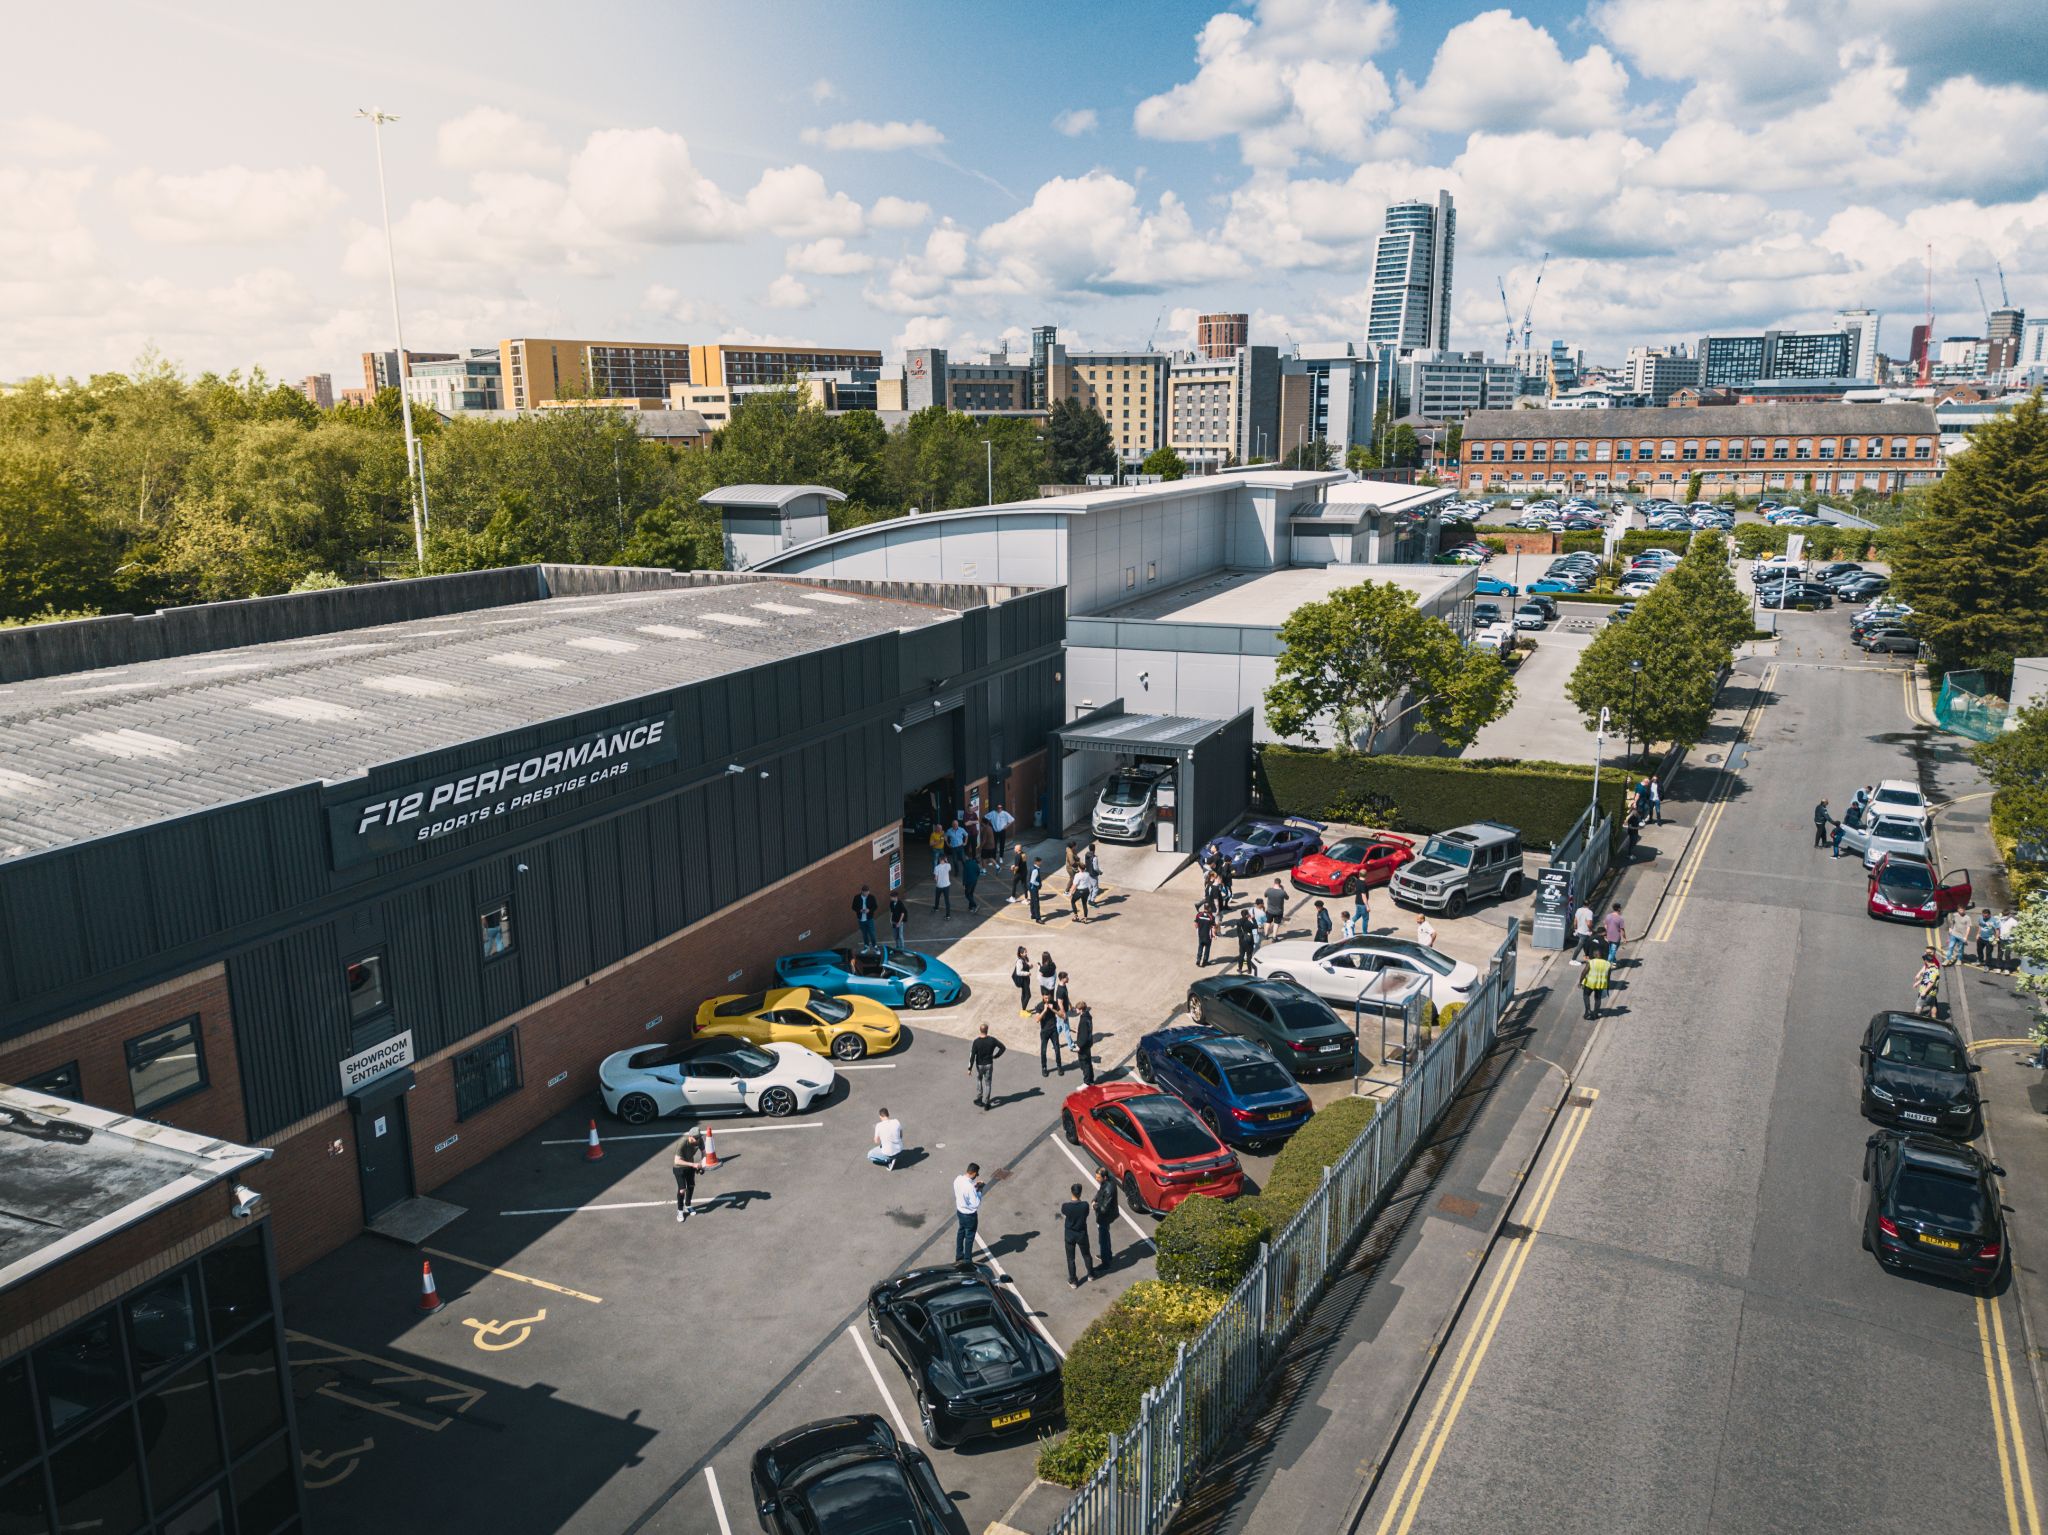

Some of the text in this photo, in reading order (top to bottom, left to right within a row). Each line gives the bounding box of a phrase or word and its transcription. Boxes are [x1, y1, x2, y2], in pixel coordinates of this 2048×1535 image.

[358, 721, 665, 834] F12 PERFORMANCE
[417, 762, 629, 841] SPORTS & PRESTIGE CARS
[346, 1038, 408, 1074] SHOWROOM
[352, 1051, 406, 1084] ENTRANCE
